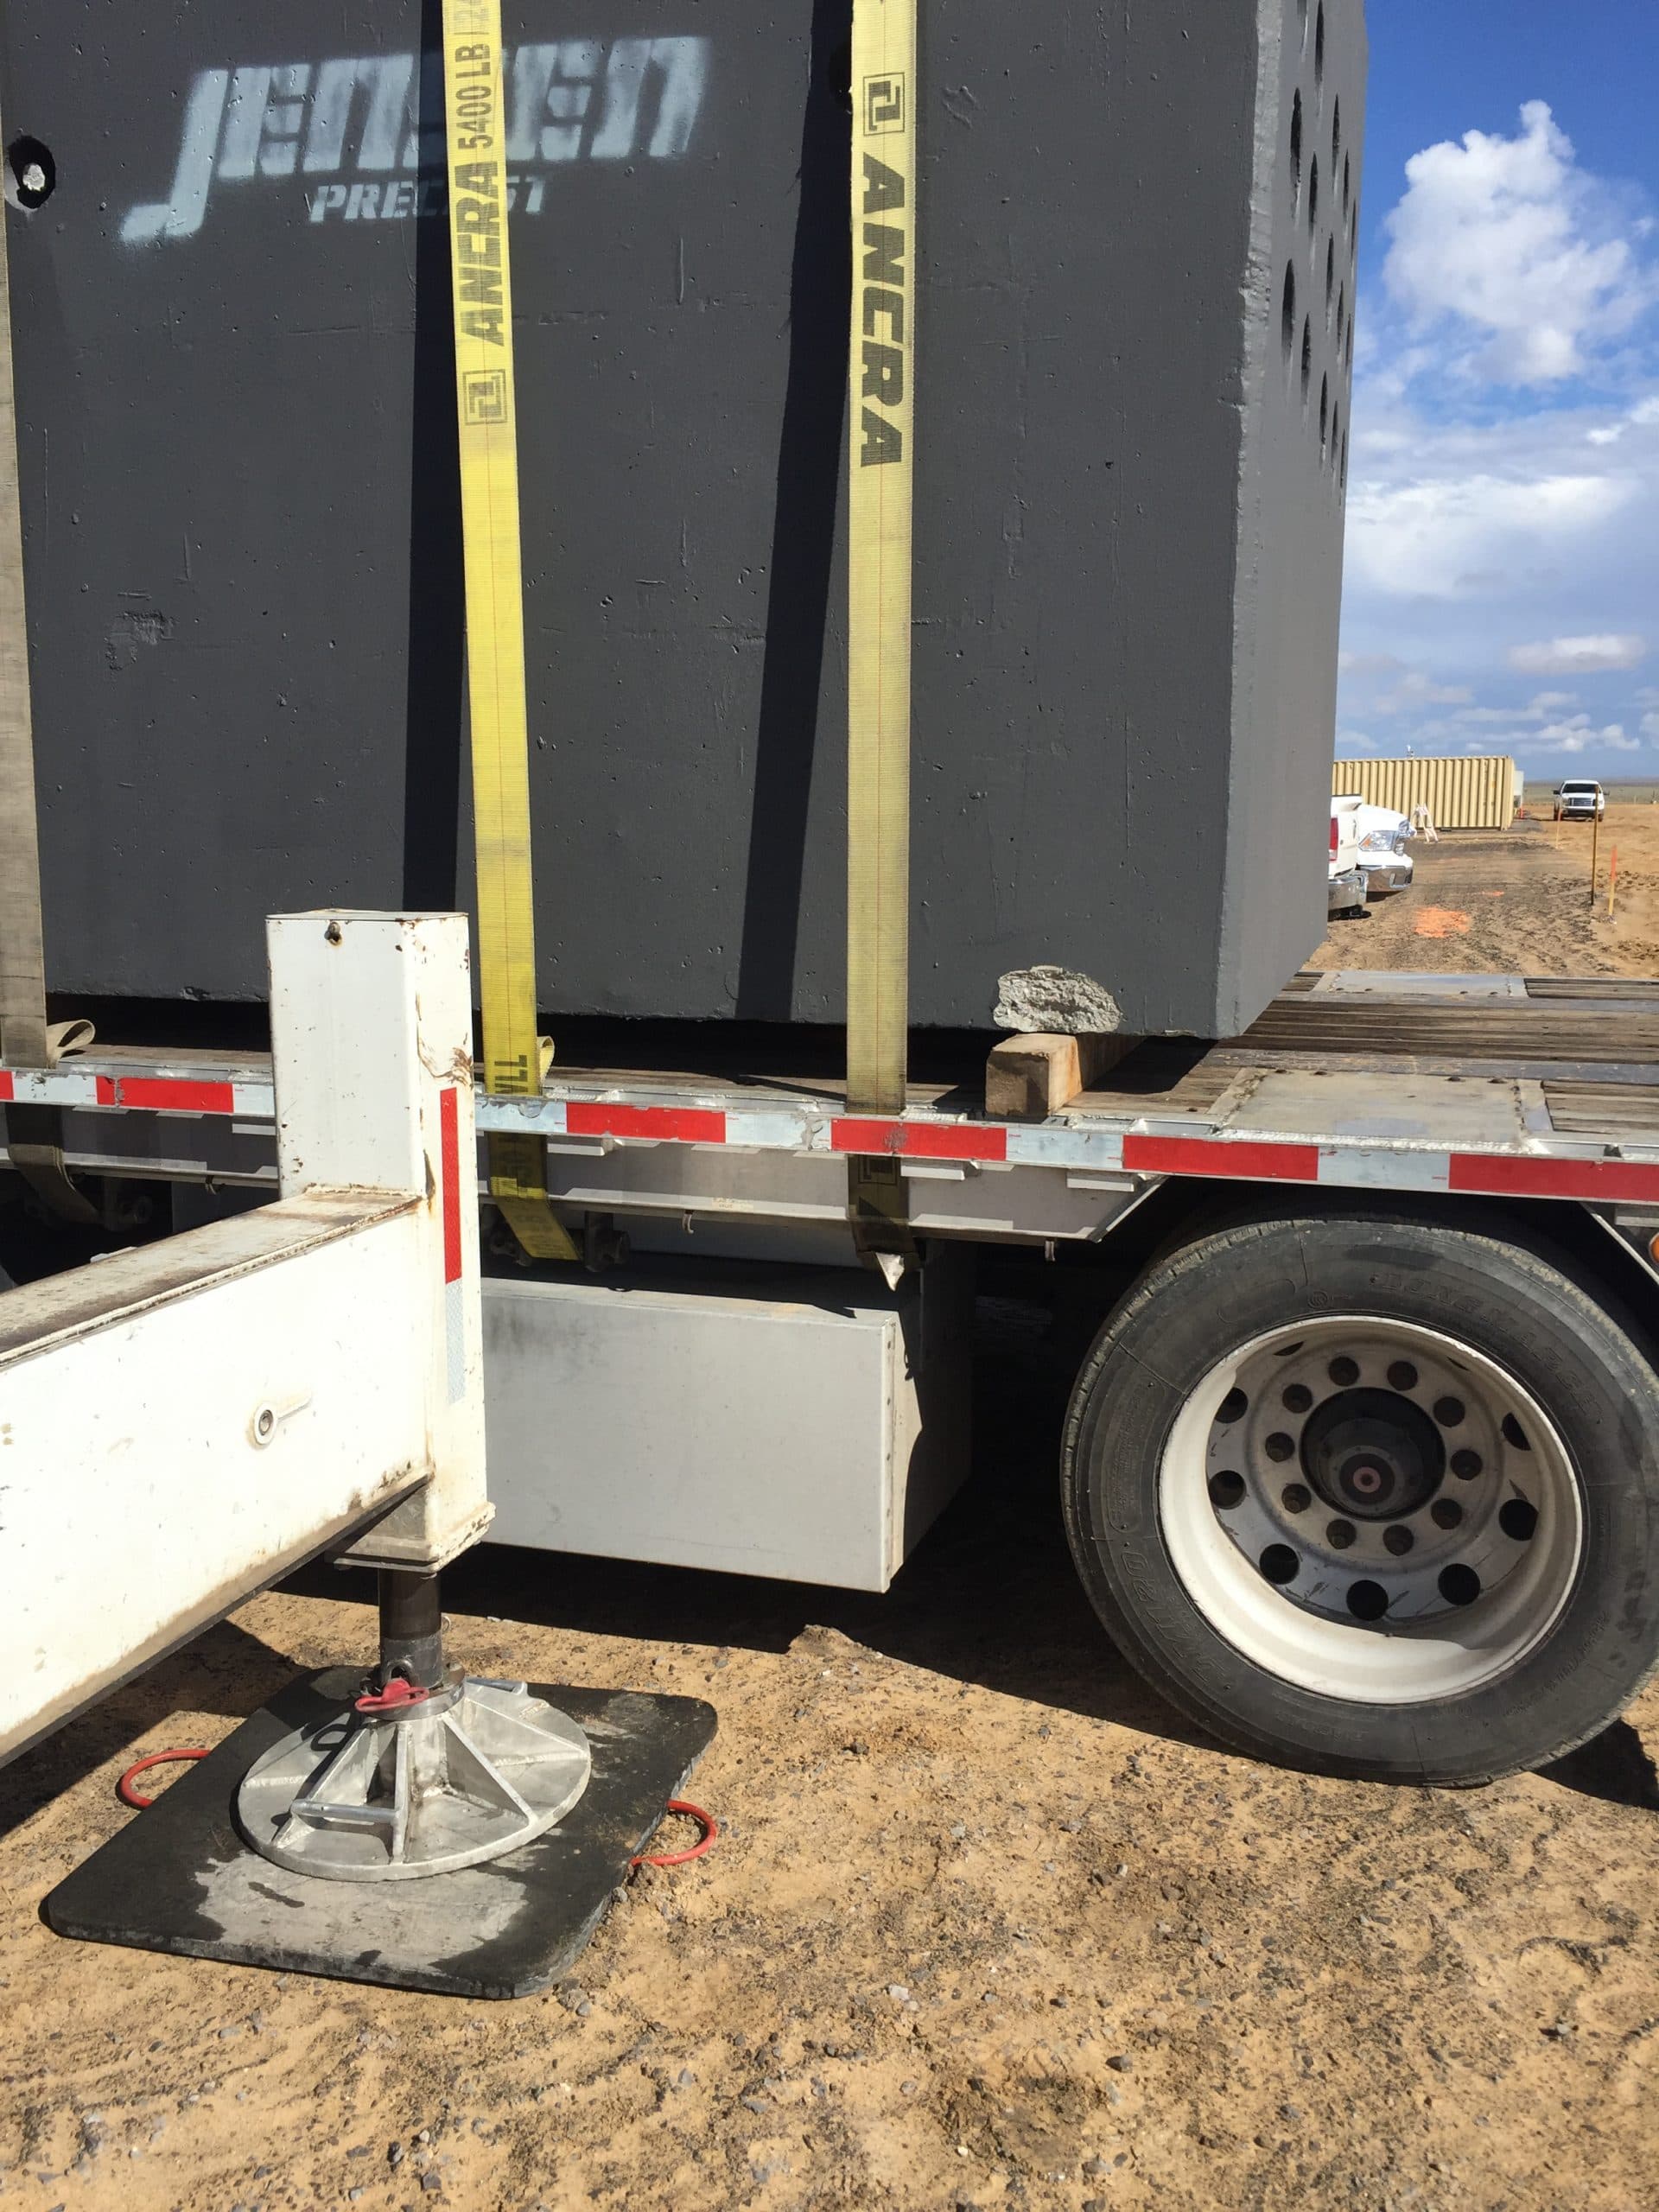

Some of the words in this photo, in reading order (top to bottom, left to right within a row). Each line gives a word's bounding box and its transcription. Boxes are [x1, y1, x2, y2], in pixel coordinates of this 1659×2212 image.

[454, 43, 491, 82] LB
[456, 85, 494, 150] 5400
[308, 176, 550, 222] PRECT
[455, 161, 505, 346] ANCRA
[861, 152, 906, 467] ANCRA
